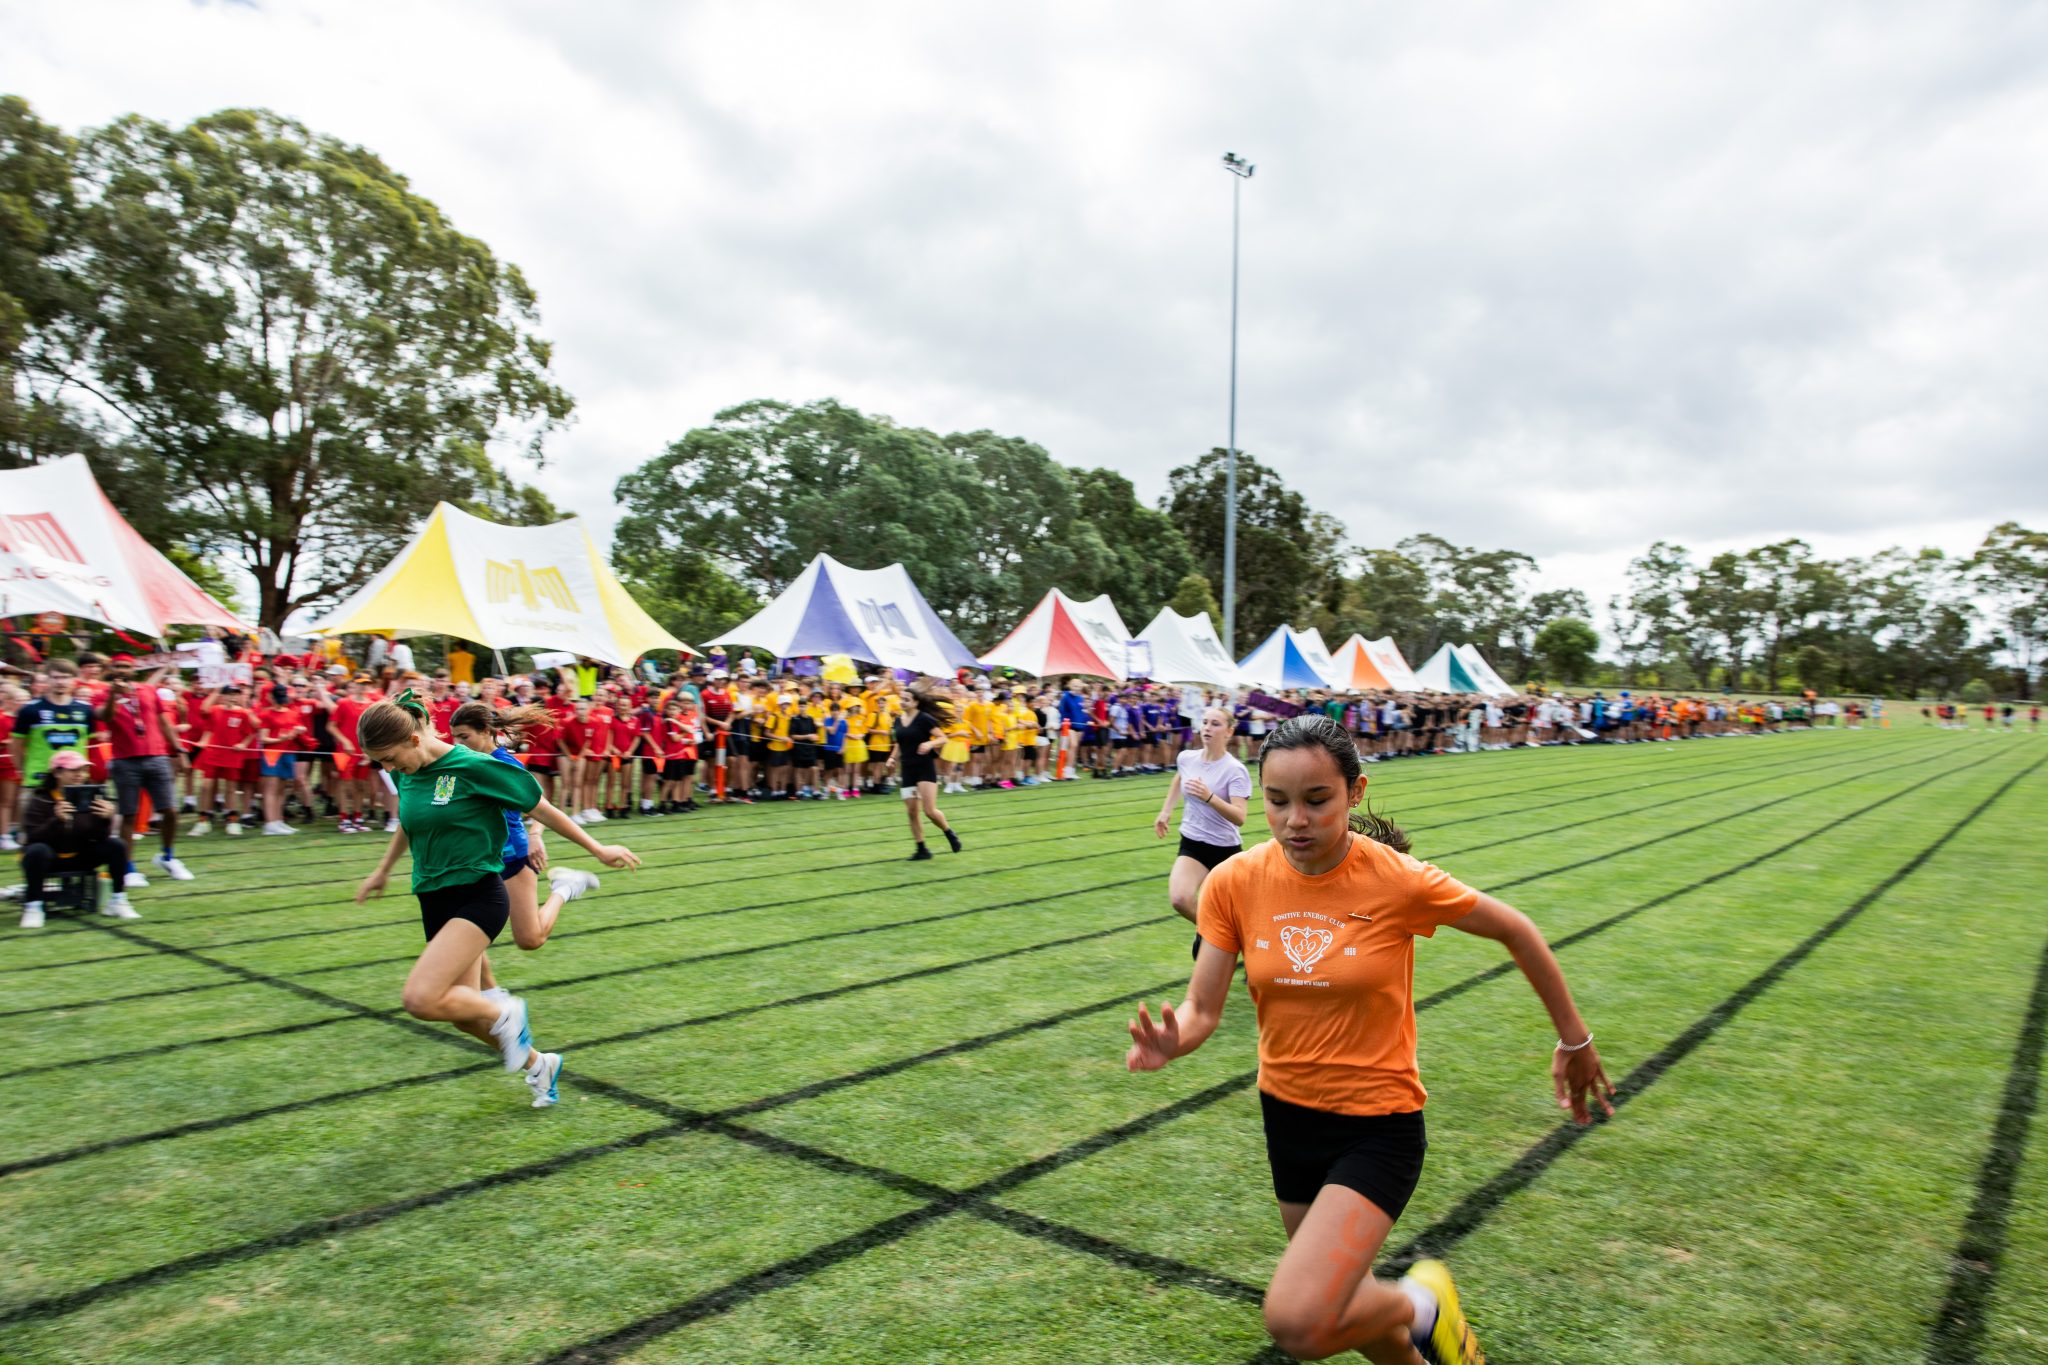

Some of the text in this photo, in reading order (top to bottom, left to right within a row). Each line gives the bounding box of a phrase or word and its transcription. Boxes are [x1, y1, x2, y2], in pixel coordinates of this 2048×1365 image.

[1273, 912, 1346, 929] POSITIVE ENERGY CLUB
[1295, 939, 1316, 956] 89
